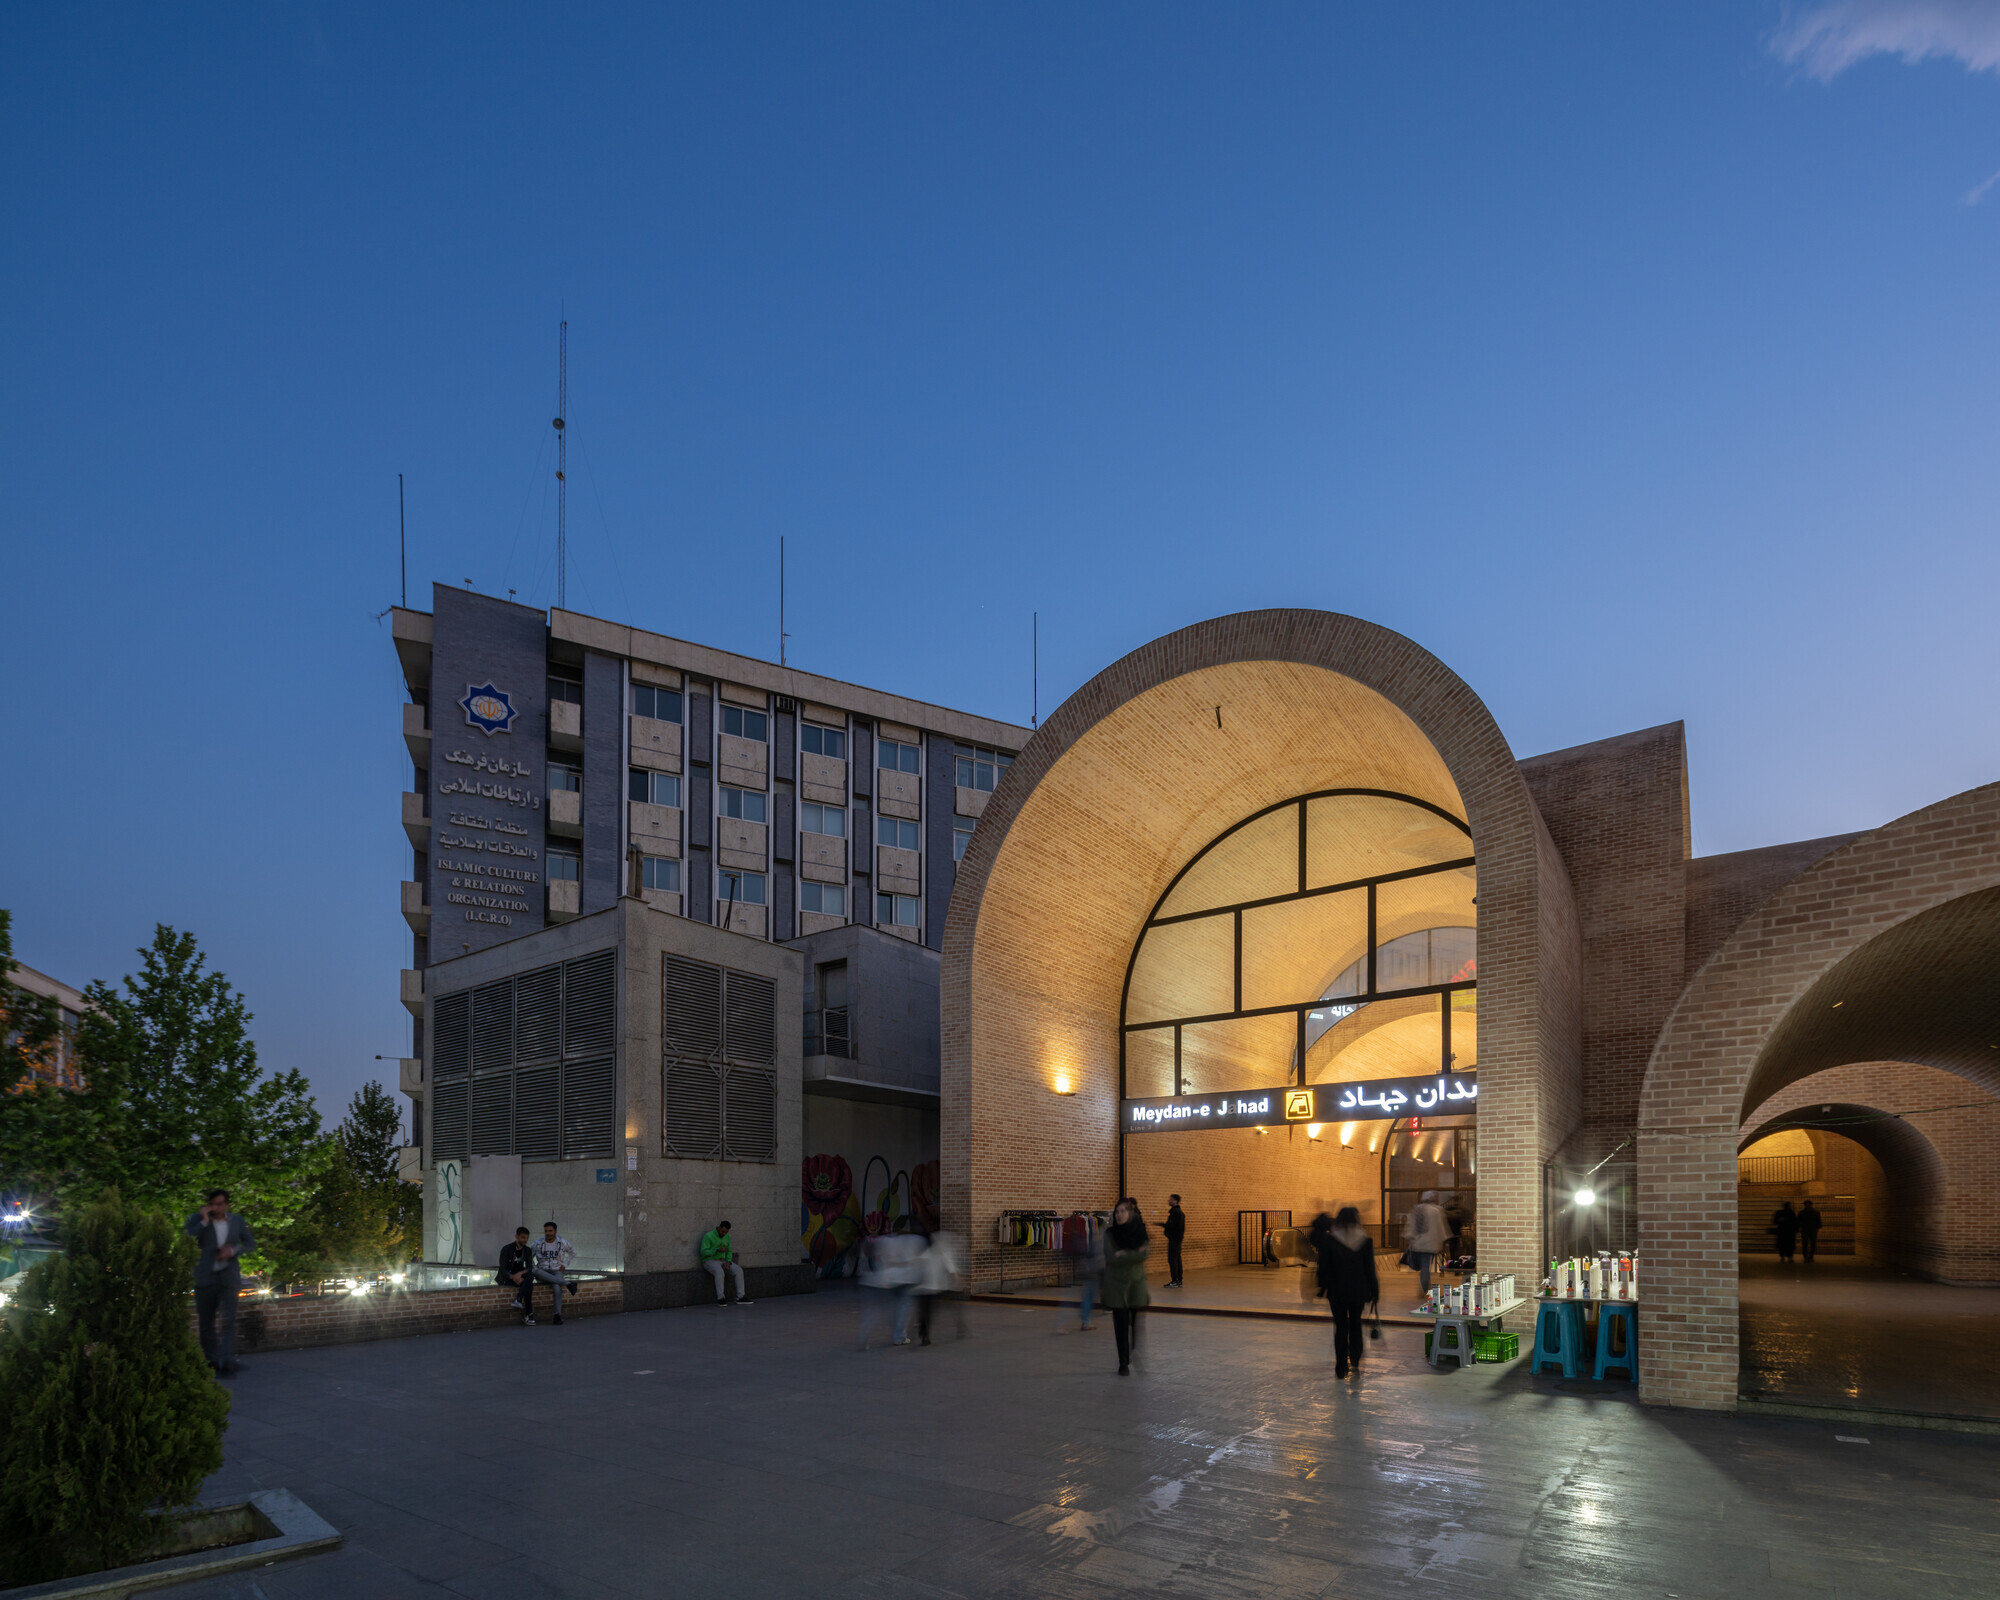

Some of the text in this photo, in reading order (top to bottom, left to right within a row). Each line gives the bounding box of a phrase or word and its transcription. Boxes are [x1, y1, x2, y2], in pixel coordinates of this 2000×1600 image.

[488, 758, 530, 778] سازمان
[439, 777, 540, 809] و ارتباطات اسلامی
[449, 811, 528, 836] منظمة الثقافة
[437, 859, 539, 882] ISLAMIC CULTURE
[451, 877, 525, 895] & RELATIONS
[447, 892, 529, 912] ORGANIZATION
[465, 910, 512, 927] (I.C.R.O)
[1132, 1097, 1270, 1124] Meydan-e Jahad
[1339, 1086, 1409, 1112] جهاد
